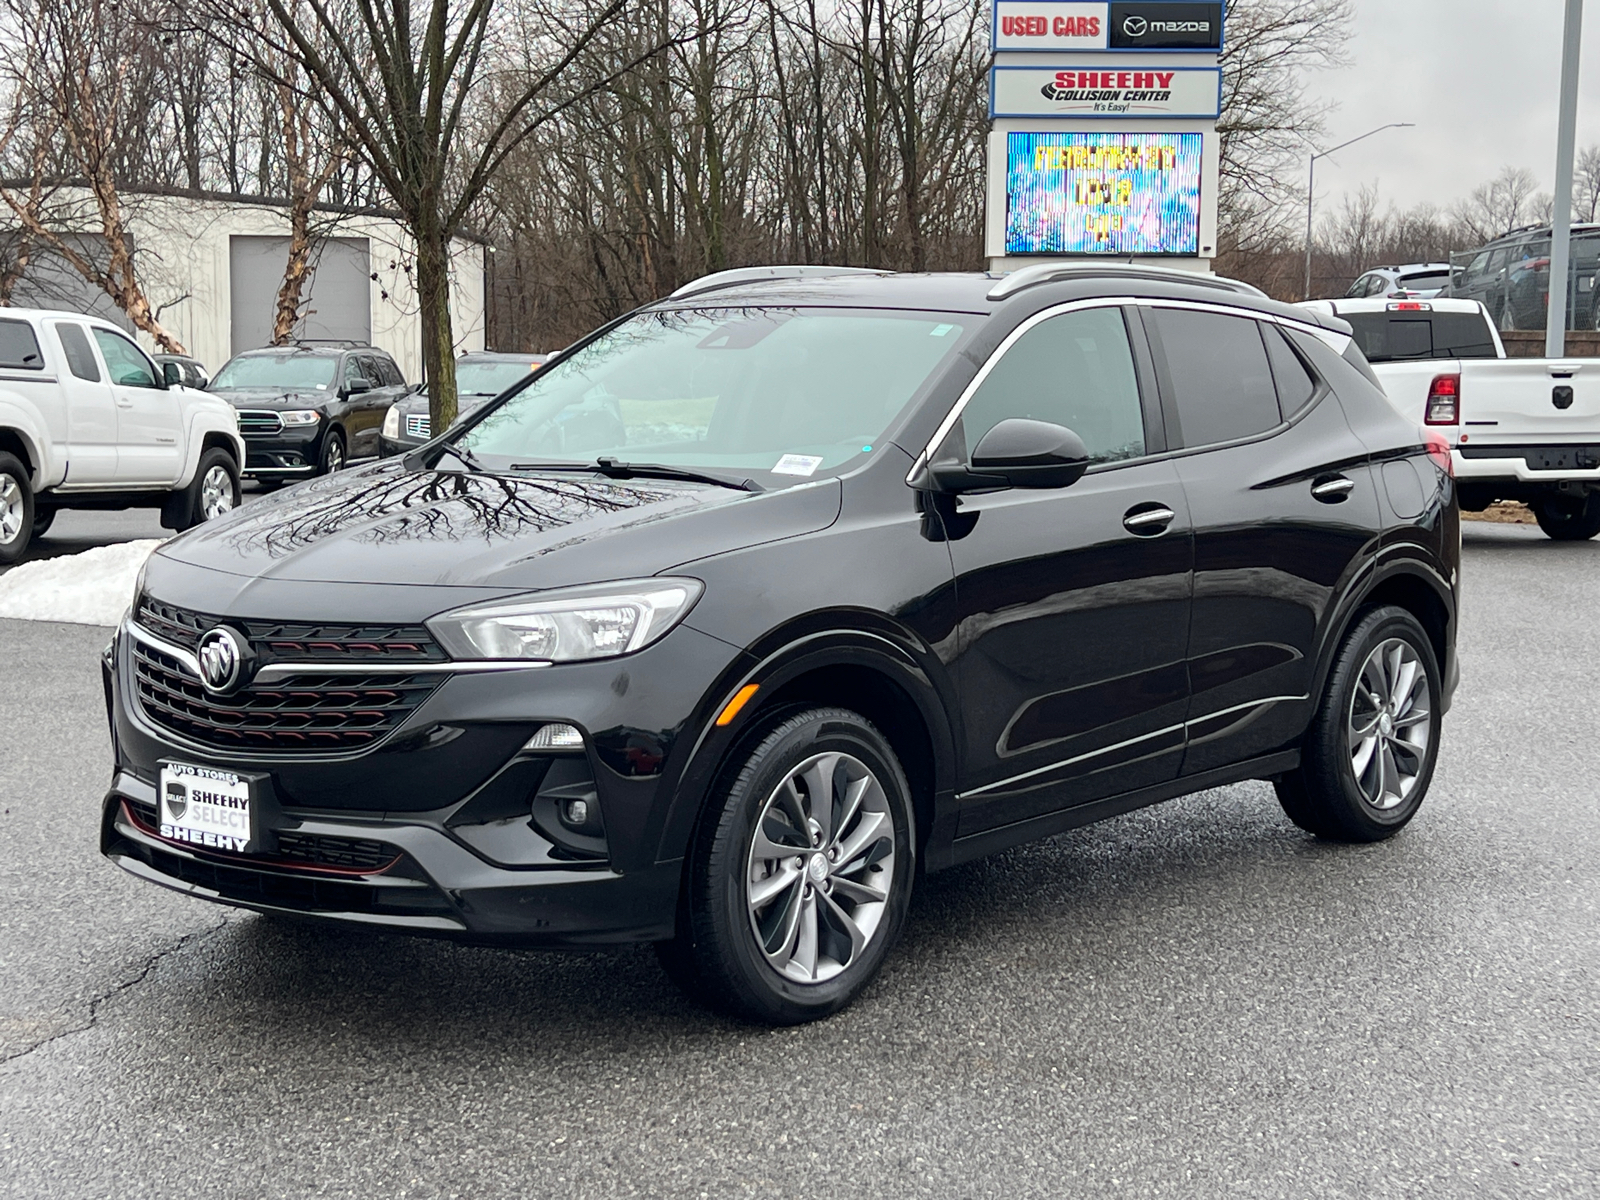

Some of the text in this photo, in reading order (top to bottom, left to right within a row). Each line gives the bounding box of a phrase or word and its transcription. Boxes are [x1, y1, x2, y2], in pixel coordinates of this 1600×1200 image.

[1002, 15, 1100, 37] USED CARS
[1055, 72, 1175, 89] SHEEHY
[1055, 90, 1171, 101] COLLISION CENTER
[1093, 102, 1130, 113] It's Easy!
[167, 763, 239, 783] AUTO STORES
[192, 789, 249, 810] SHEEHY
[192, 805, 249, 829] SELECT
[160, 824, 249, 852] SHEEHY
